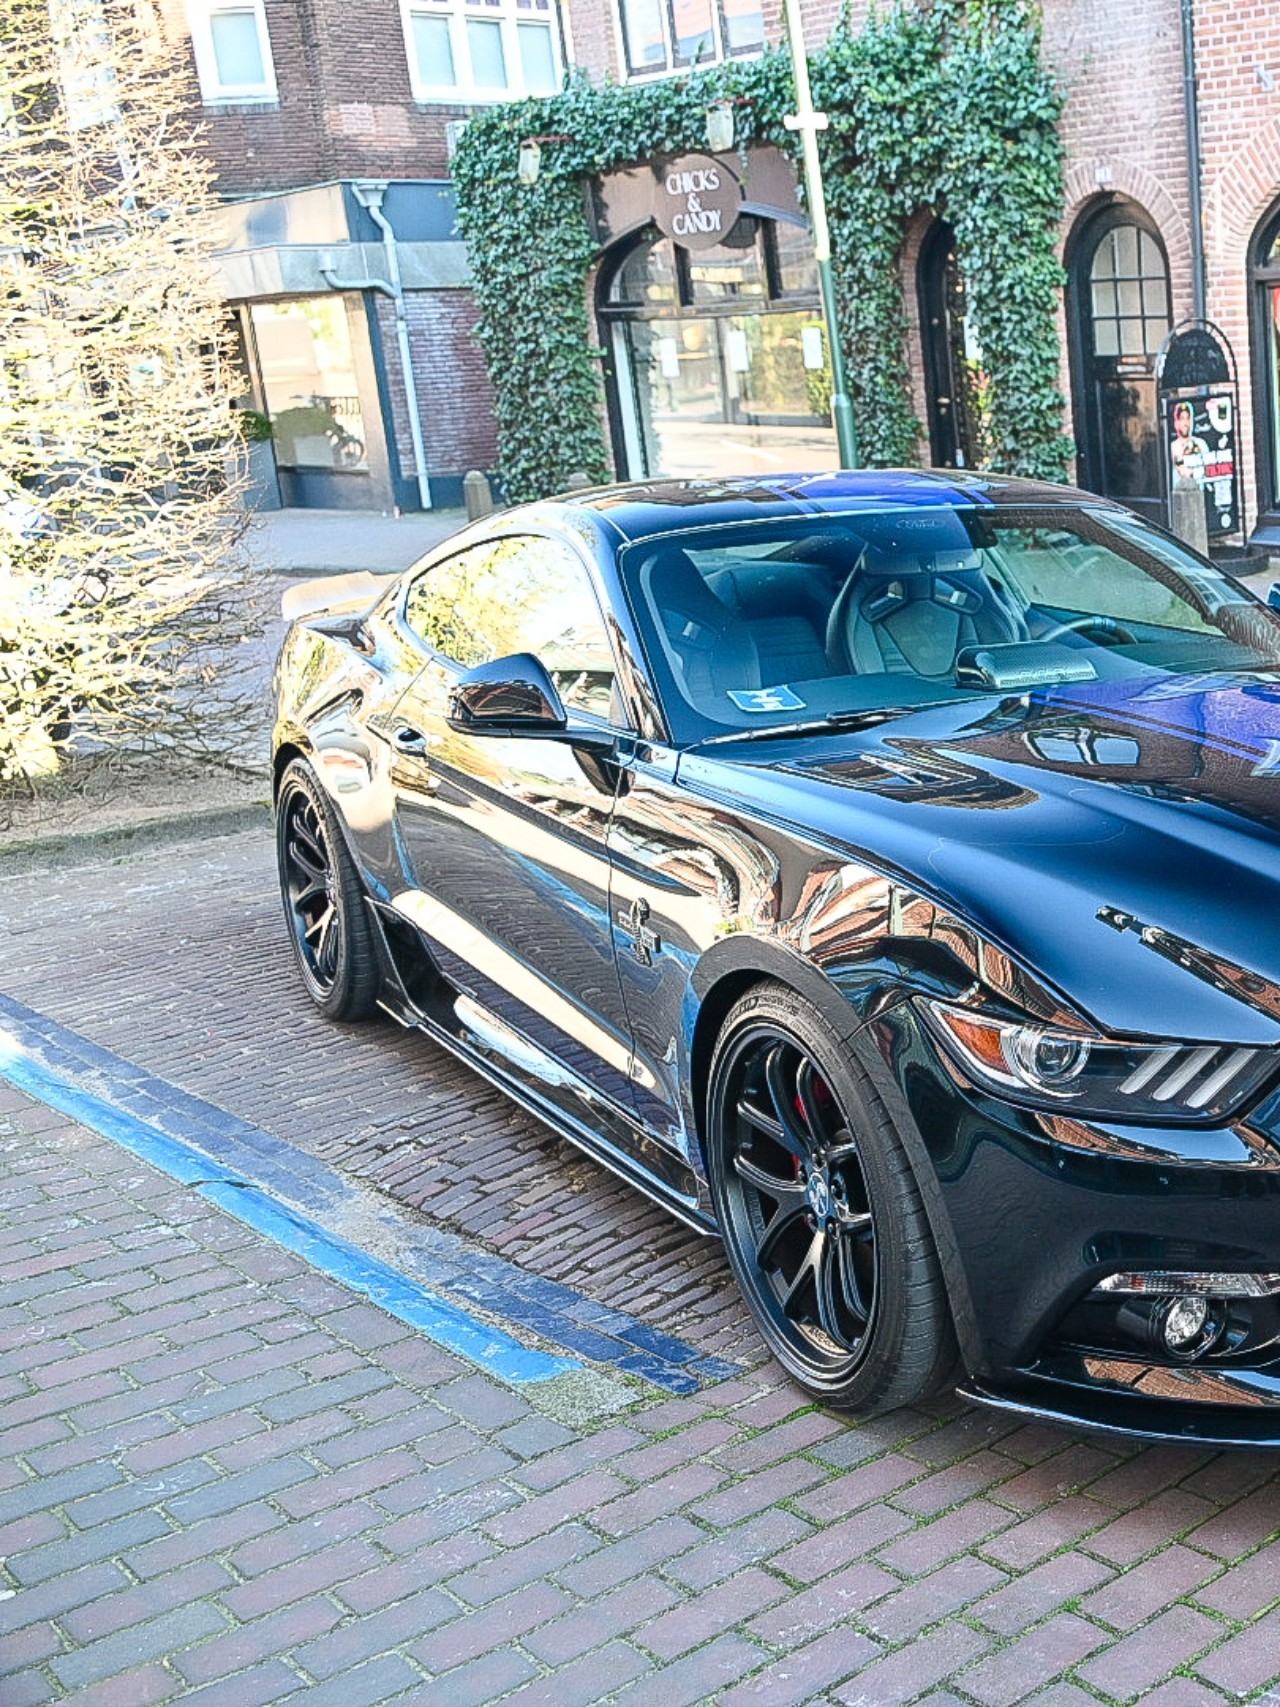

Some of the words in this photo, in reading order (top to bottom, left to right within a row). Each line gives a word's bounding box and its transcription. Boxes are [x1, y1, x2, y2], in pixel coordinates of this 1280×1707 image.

[666, 168, 720, 195] CHICKS
[687, 192, 702, 213] &
[672, 209, 721, 235] CANDY
